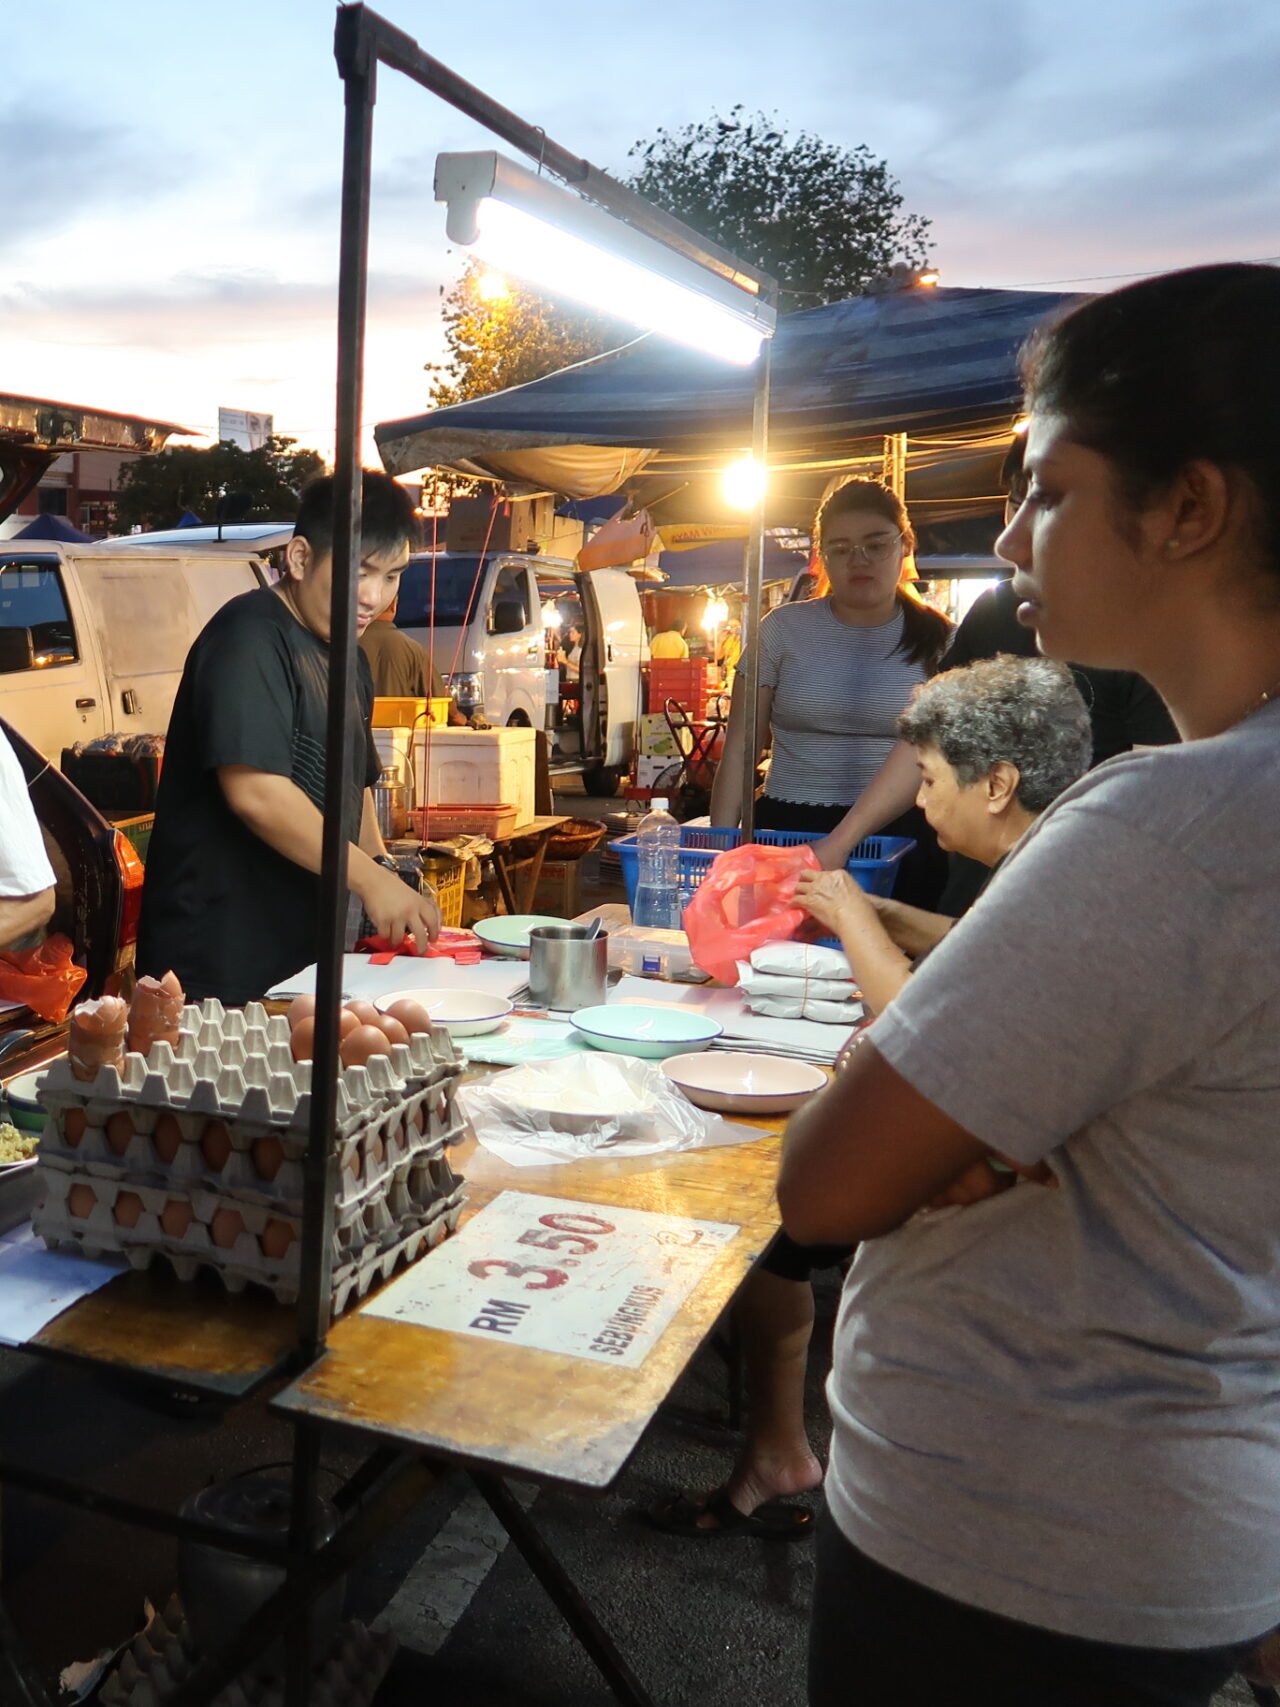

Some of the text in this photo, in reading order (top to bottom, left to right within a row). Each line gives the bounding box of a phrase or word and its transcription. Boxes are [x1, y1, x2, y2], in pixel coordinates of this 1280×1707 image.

[467, 1213, 616, 1334] RM 3.50
[589, 1285, 664, 1356] SEBUNGKUS
